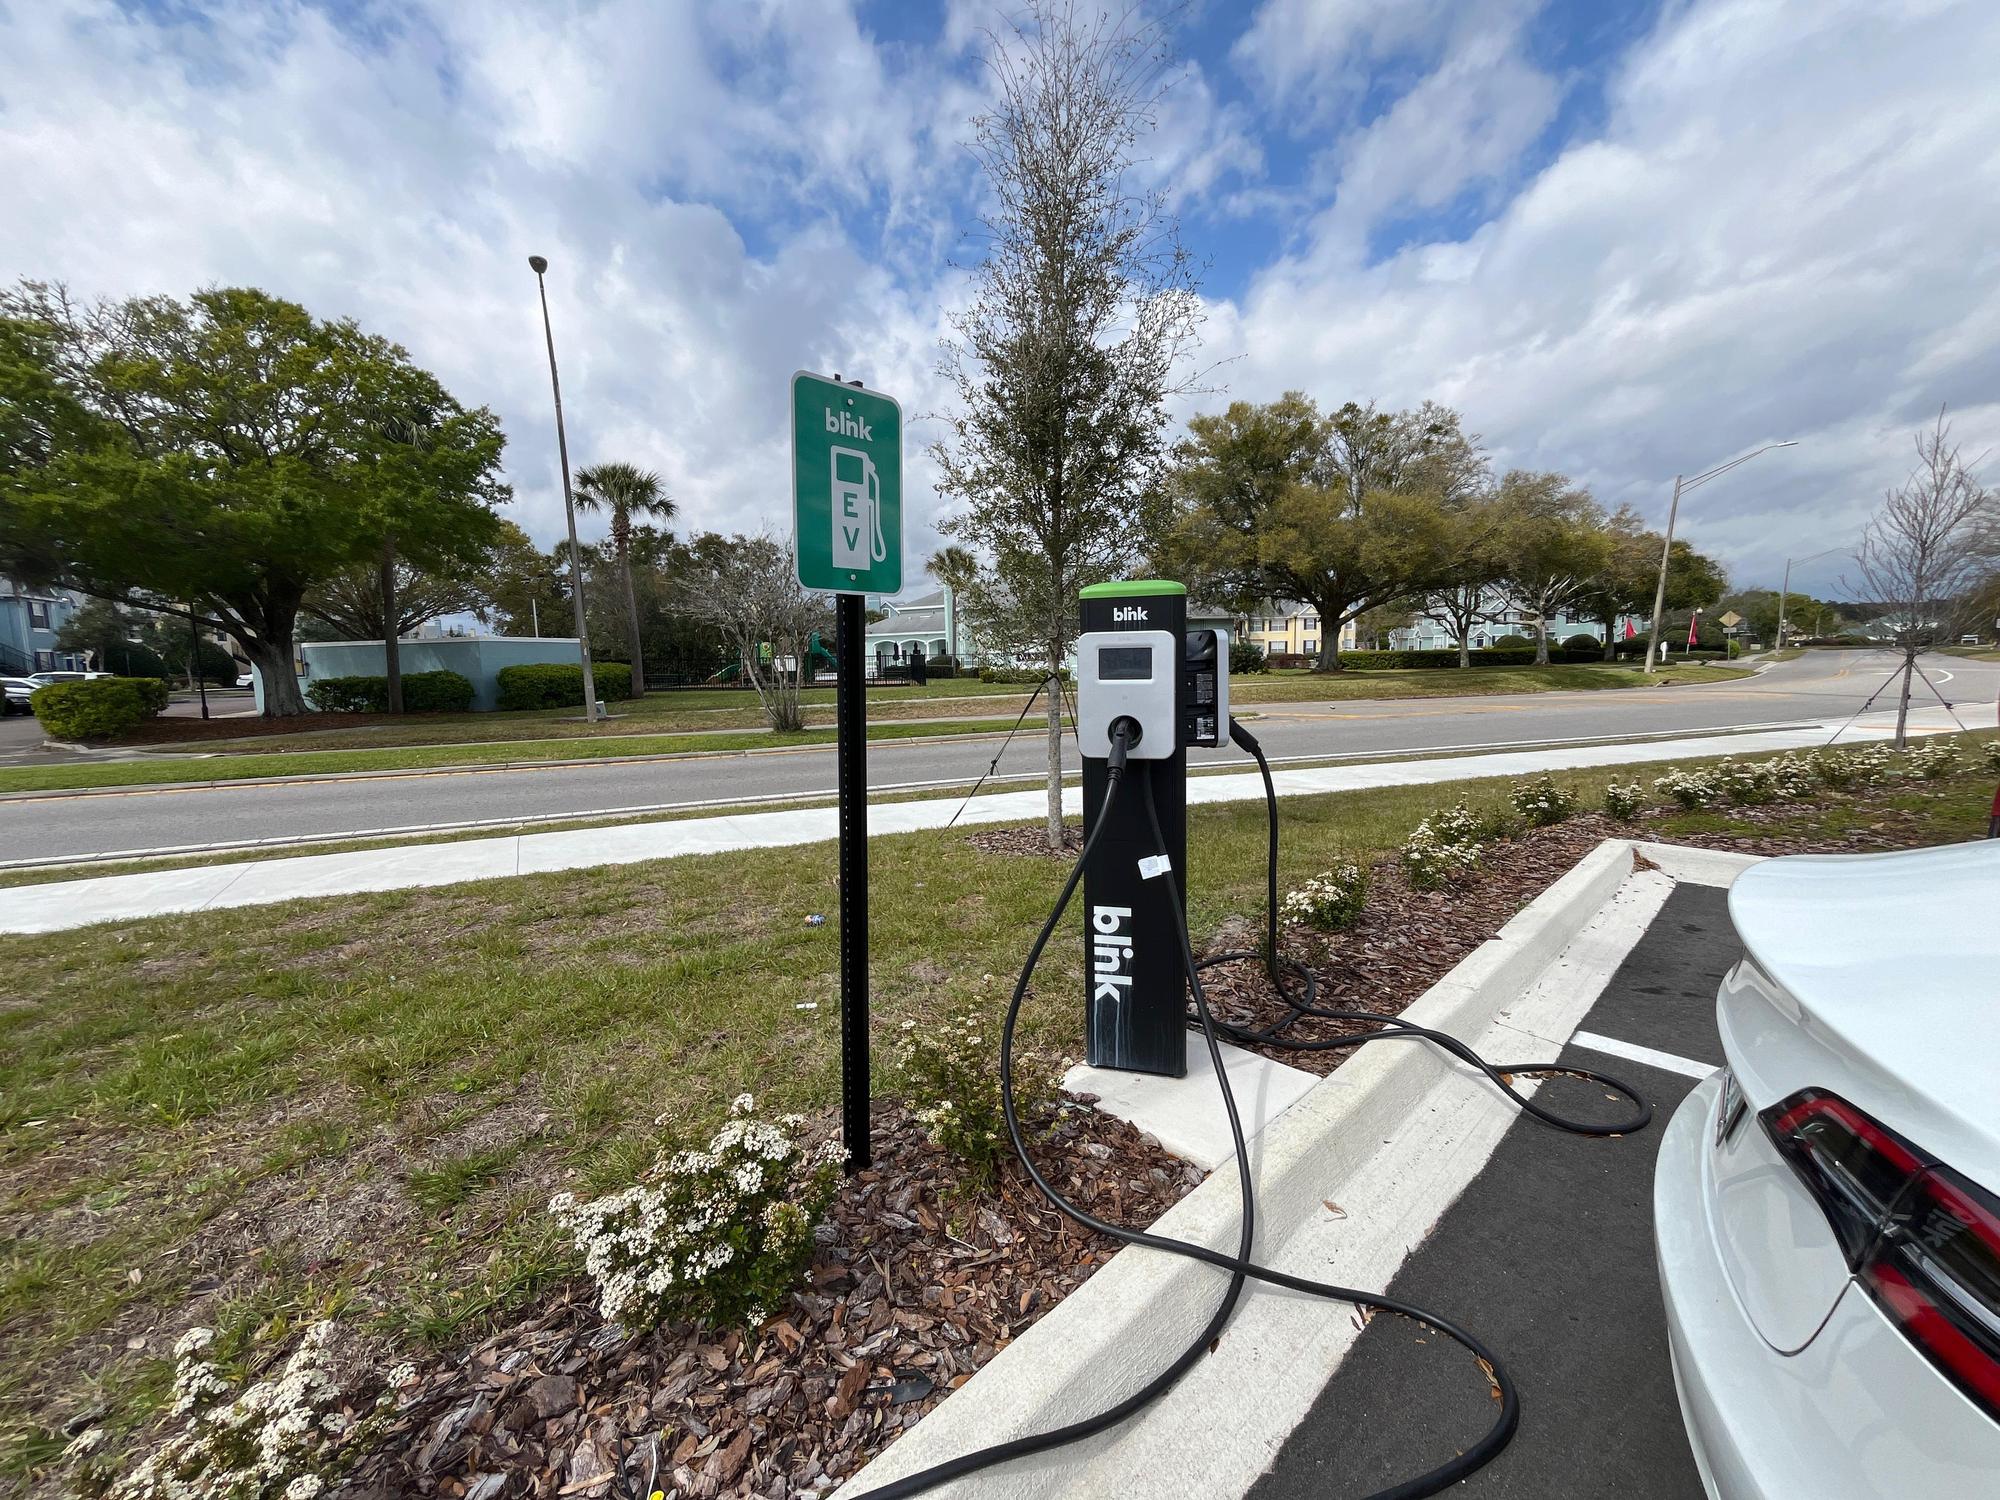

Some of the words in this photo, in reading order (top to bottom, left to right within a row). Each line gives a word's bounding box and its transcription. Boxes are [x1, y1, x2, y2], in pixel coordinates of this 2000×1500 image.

[825, 407, 873, 442] blink
[1113, 606, 1149, 622] blink
[1092, 905, 1134, 1003] blink
